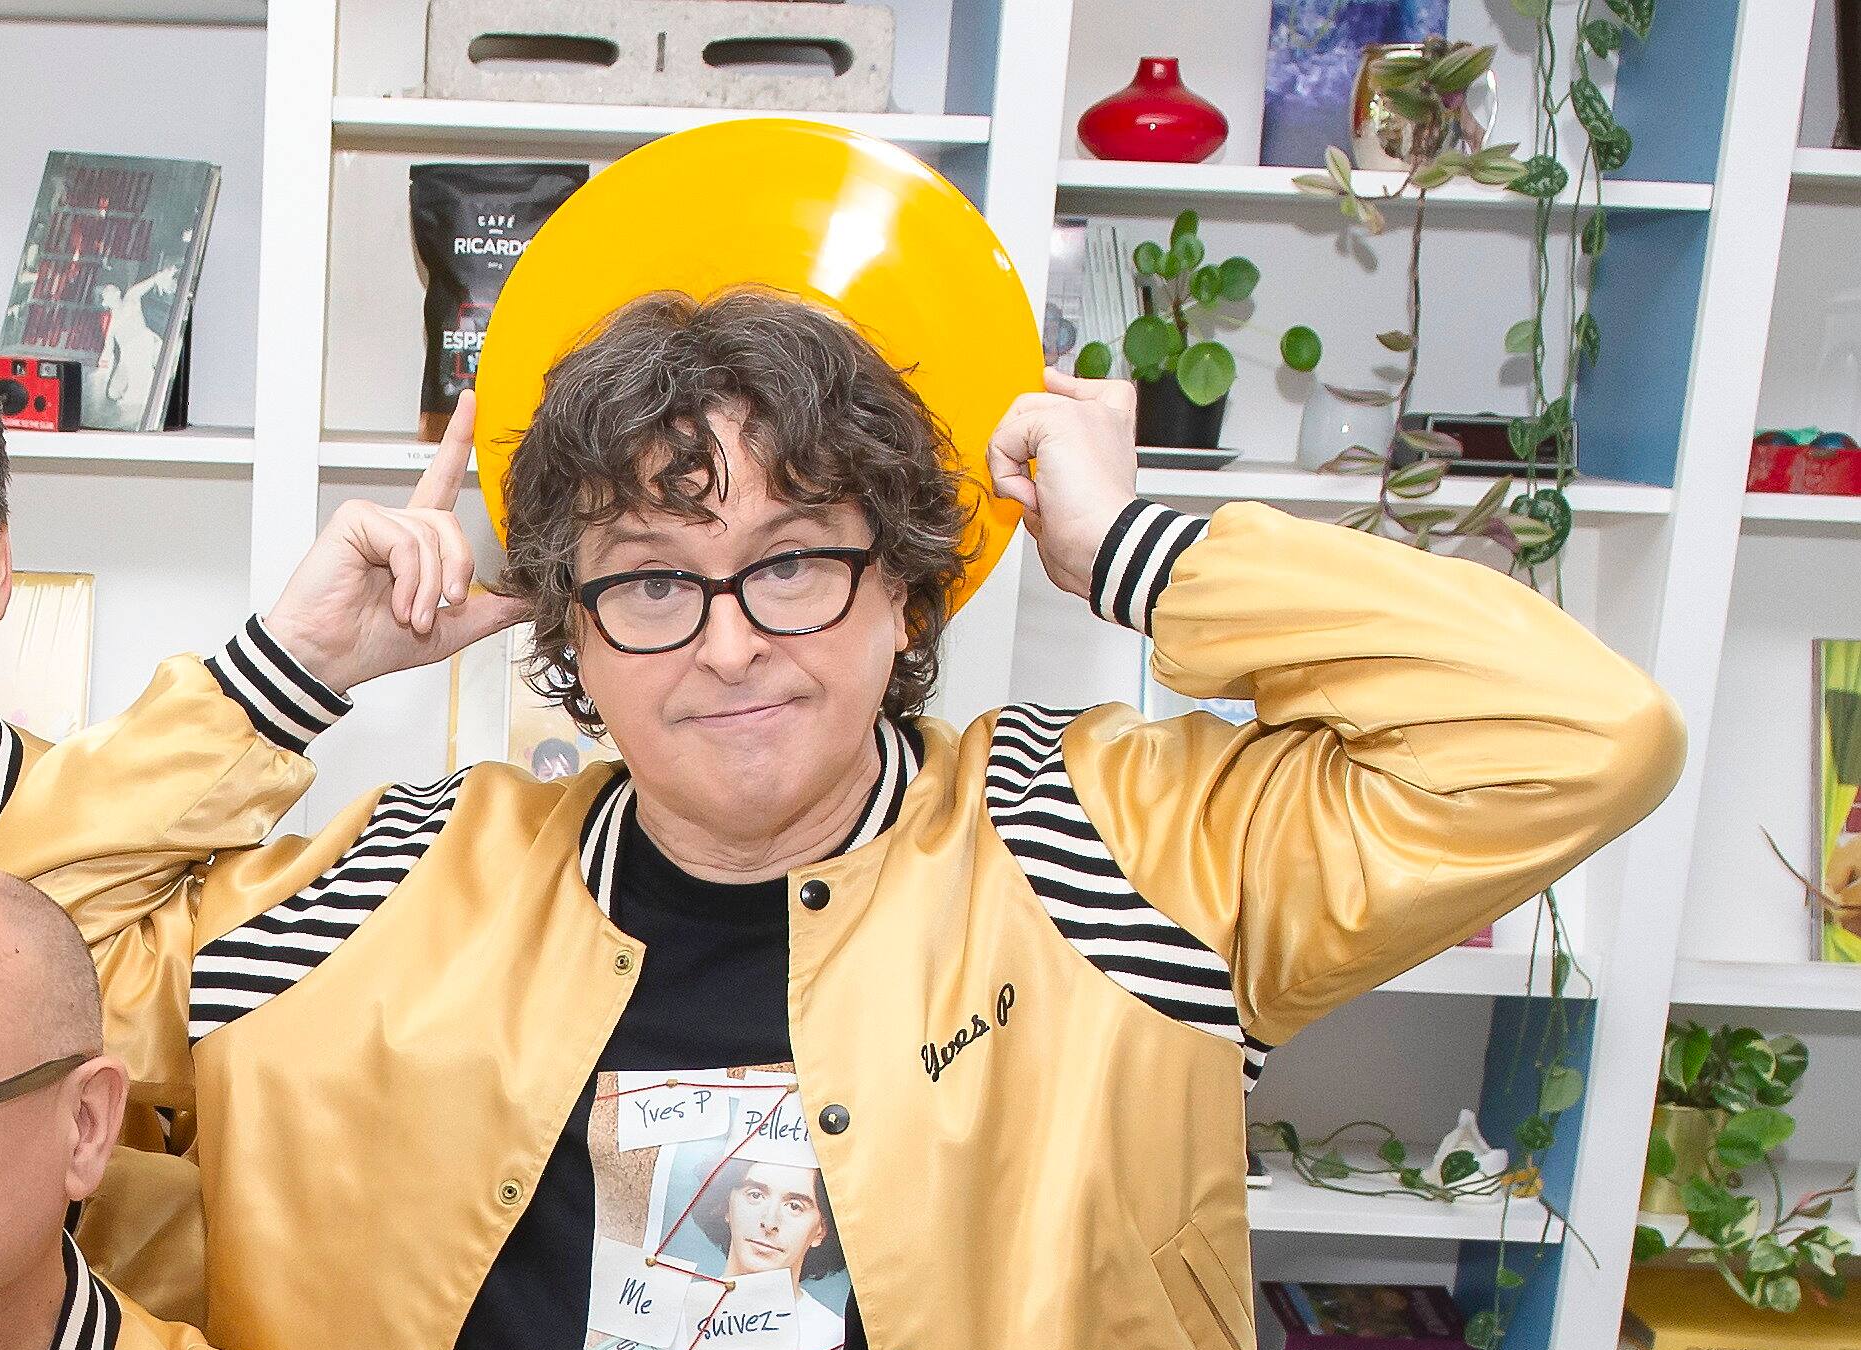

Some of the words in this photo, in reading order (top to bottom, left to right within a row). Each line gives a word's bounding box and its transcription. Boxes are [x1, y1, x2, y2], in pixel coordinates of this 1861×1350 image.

[921, 1014, 990, 1083] Yves
[997, 982, 1015, 1027] P
[635, 1099, 686, 1129] Yves
[693, 1089, 712, 1115] P
[618, 1277, 652, 1315] Me
[696, 1310, 792, 1341] suivez-
